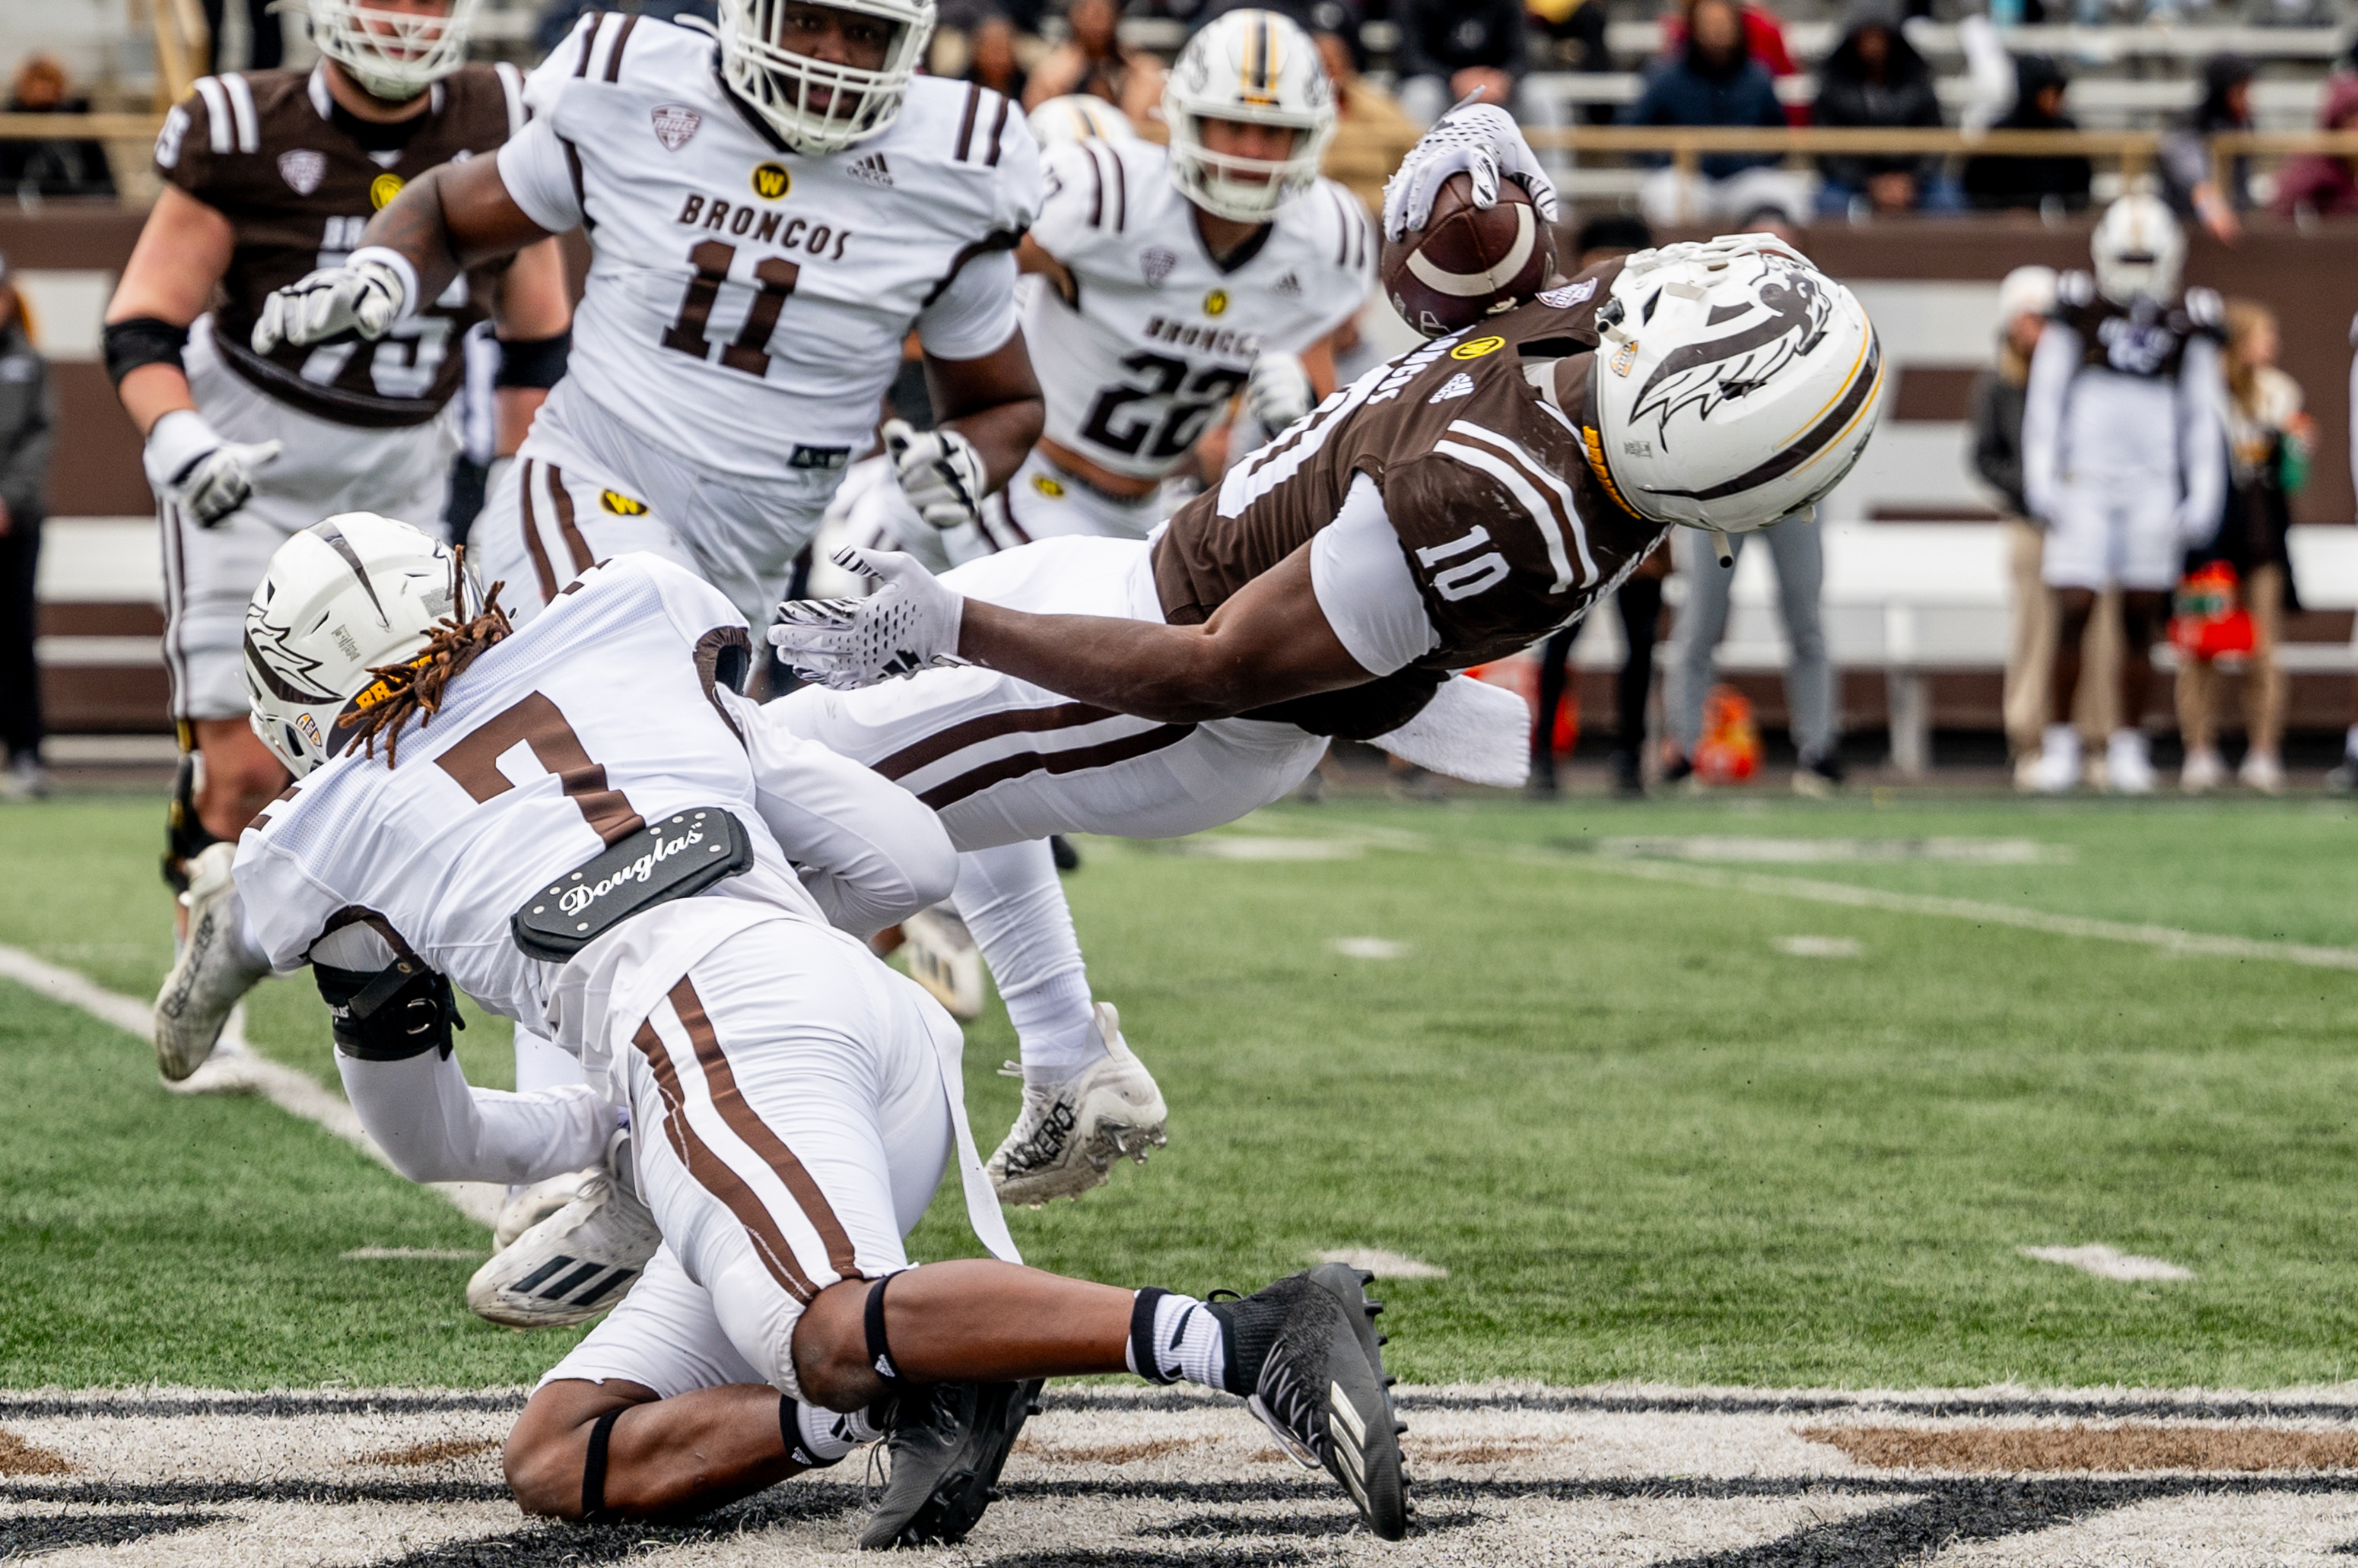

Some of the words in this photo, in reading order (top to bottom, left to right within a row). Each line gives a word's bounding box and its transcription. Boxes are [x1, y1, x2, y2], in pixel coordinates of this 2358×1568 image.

[760, 169, 786, 196] W
[677, 194, 853, 260] BRONCOS
[660, 238, 801, 379] 11
[1146, 315, 1257, 356] BRONCO
[1080, 351, 1250, 459] 22
[605, 490, 640, 515] W
[1415, 525, 1511, 601] 10
[432, 690, 646, 850] 7
[558, 829, 704, 917] Douglas
